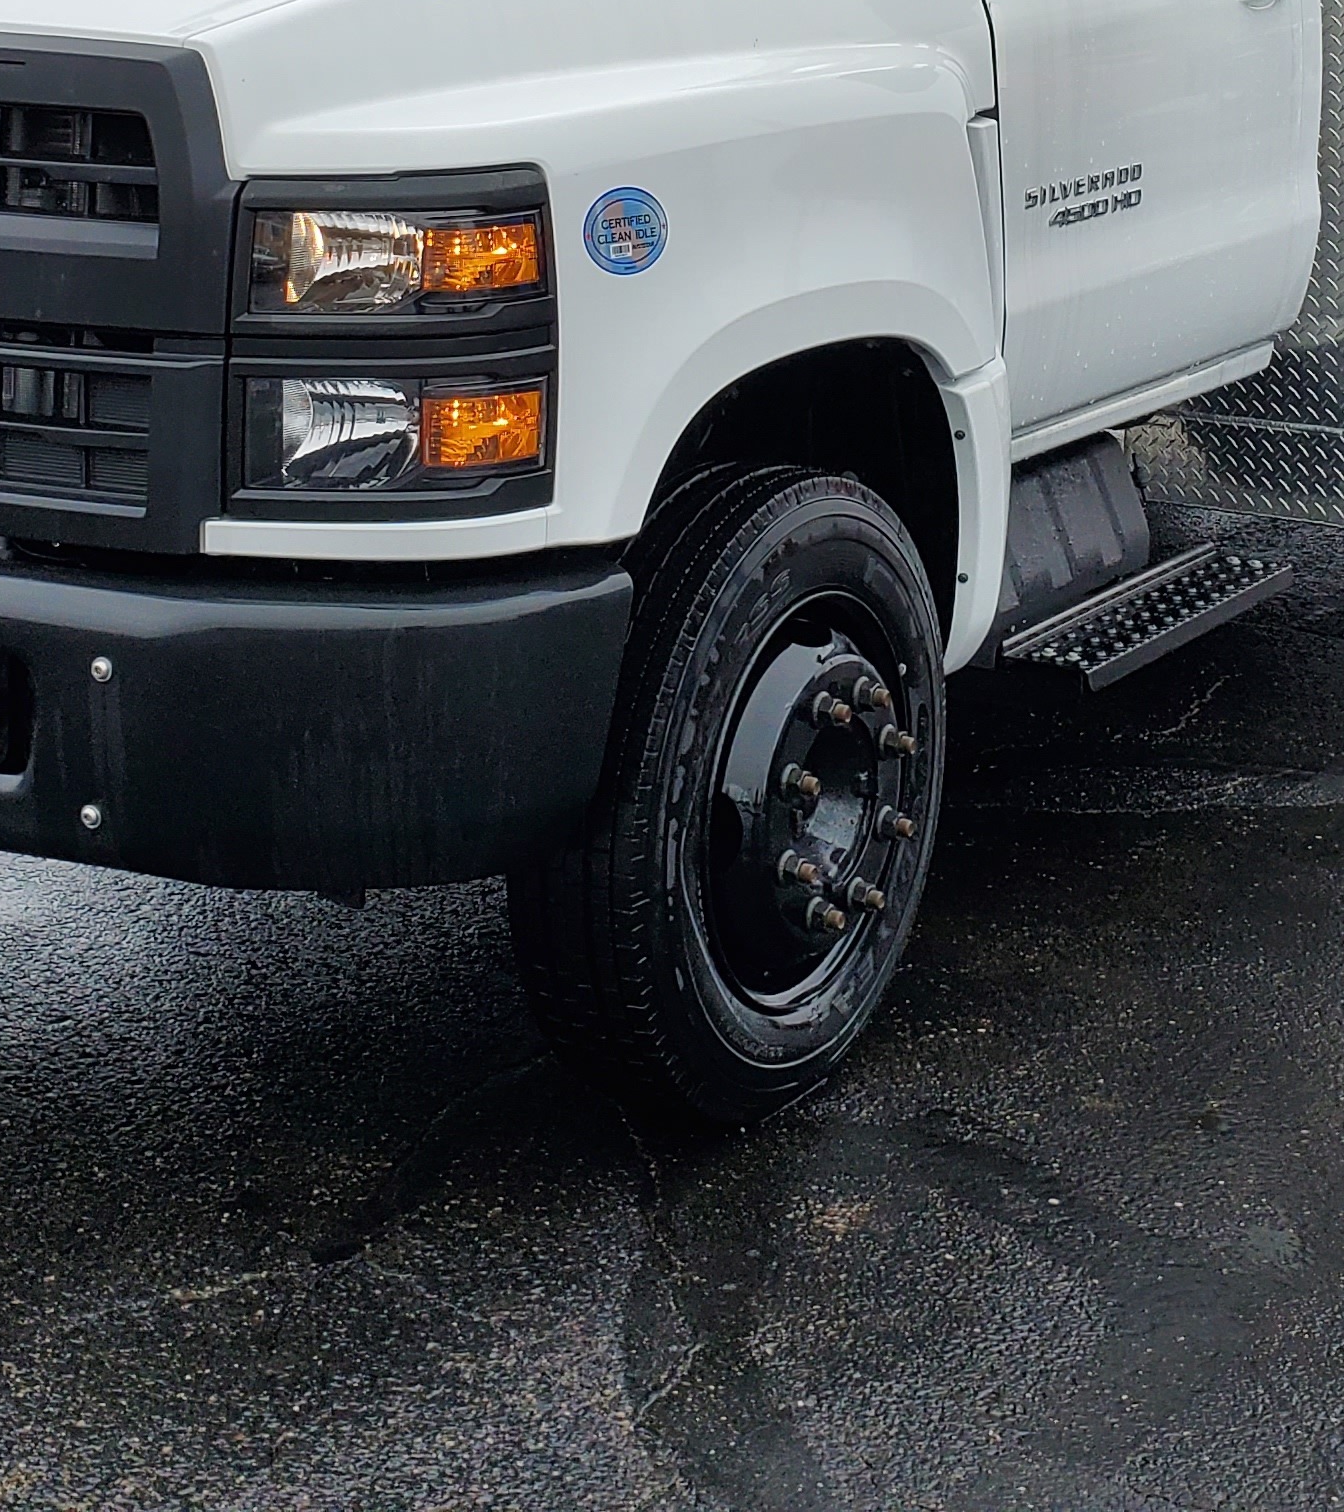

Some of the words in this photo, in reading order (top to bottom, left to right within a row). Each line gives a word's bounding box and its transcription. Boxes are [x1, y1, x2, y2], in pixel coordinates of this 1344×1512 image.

[1024, 162, 1143, 210] SILVERADO
[601, 213, 652, 230] CERTIFIED
[1048, 197, 1109, 228] 4500
[1111, 188, 1142, 214] HD
[597, 230, 632, 245] CLEAN
[635, 226, 658, 240] IDLE
